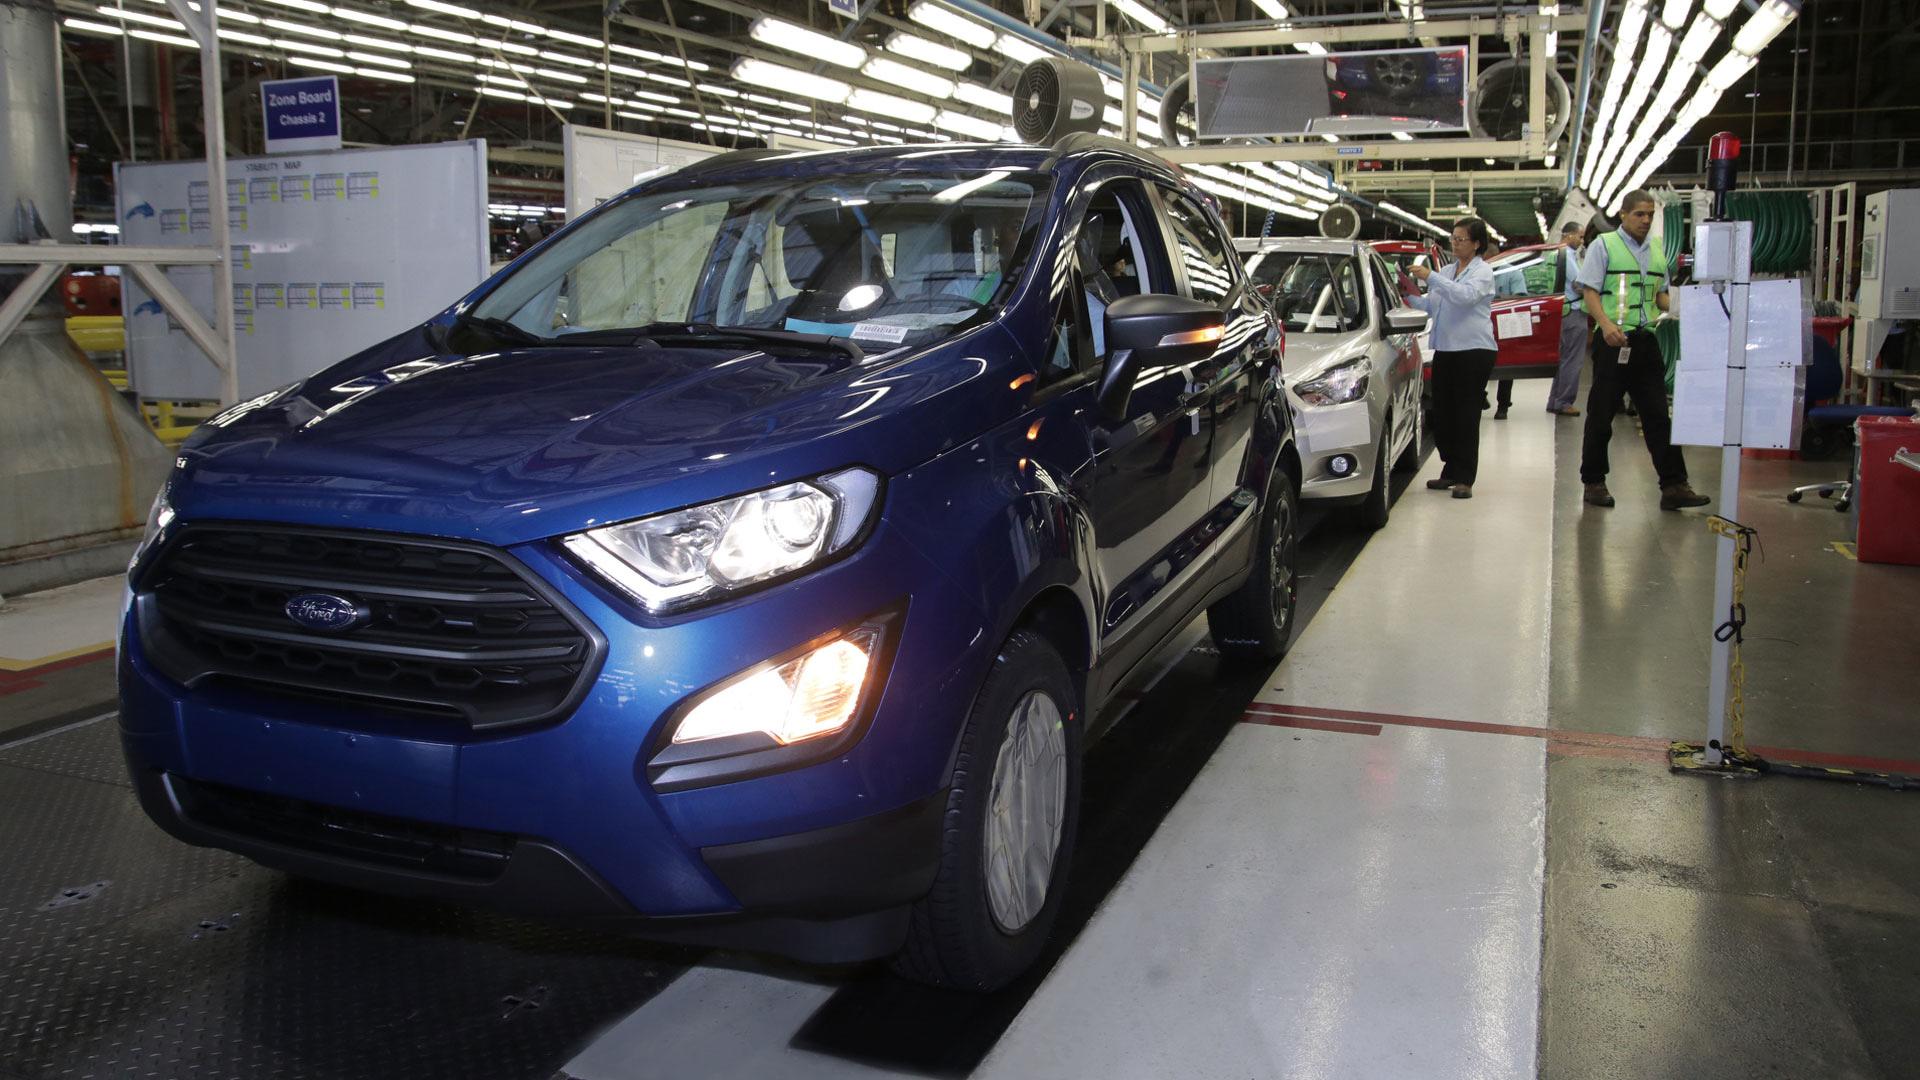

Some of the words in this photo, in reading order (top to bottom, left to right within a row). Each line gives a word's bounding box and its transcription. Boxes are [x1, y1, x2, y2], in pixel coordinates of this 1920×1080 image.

[269, 94, 297, 107] Zone
[298, 89, 332, 104] Board
[280, 112, 317, 126] Chassis
[319, 111, 326, 123] 2
[298, 599, 338, 622] Ford
